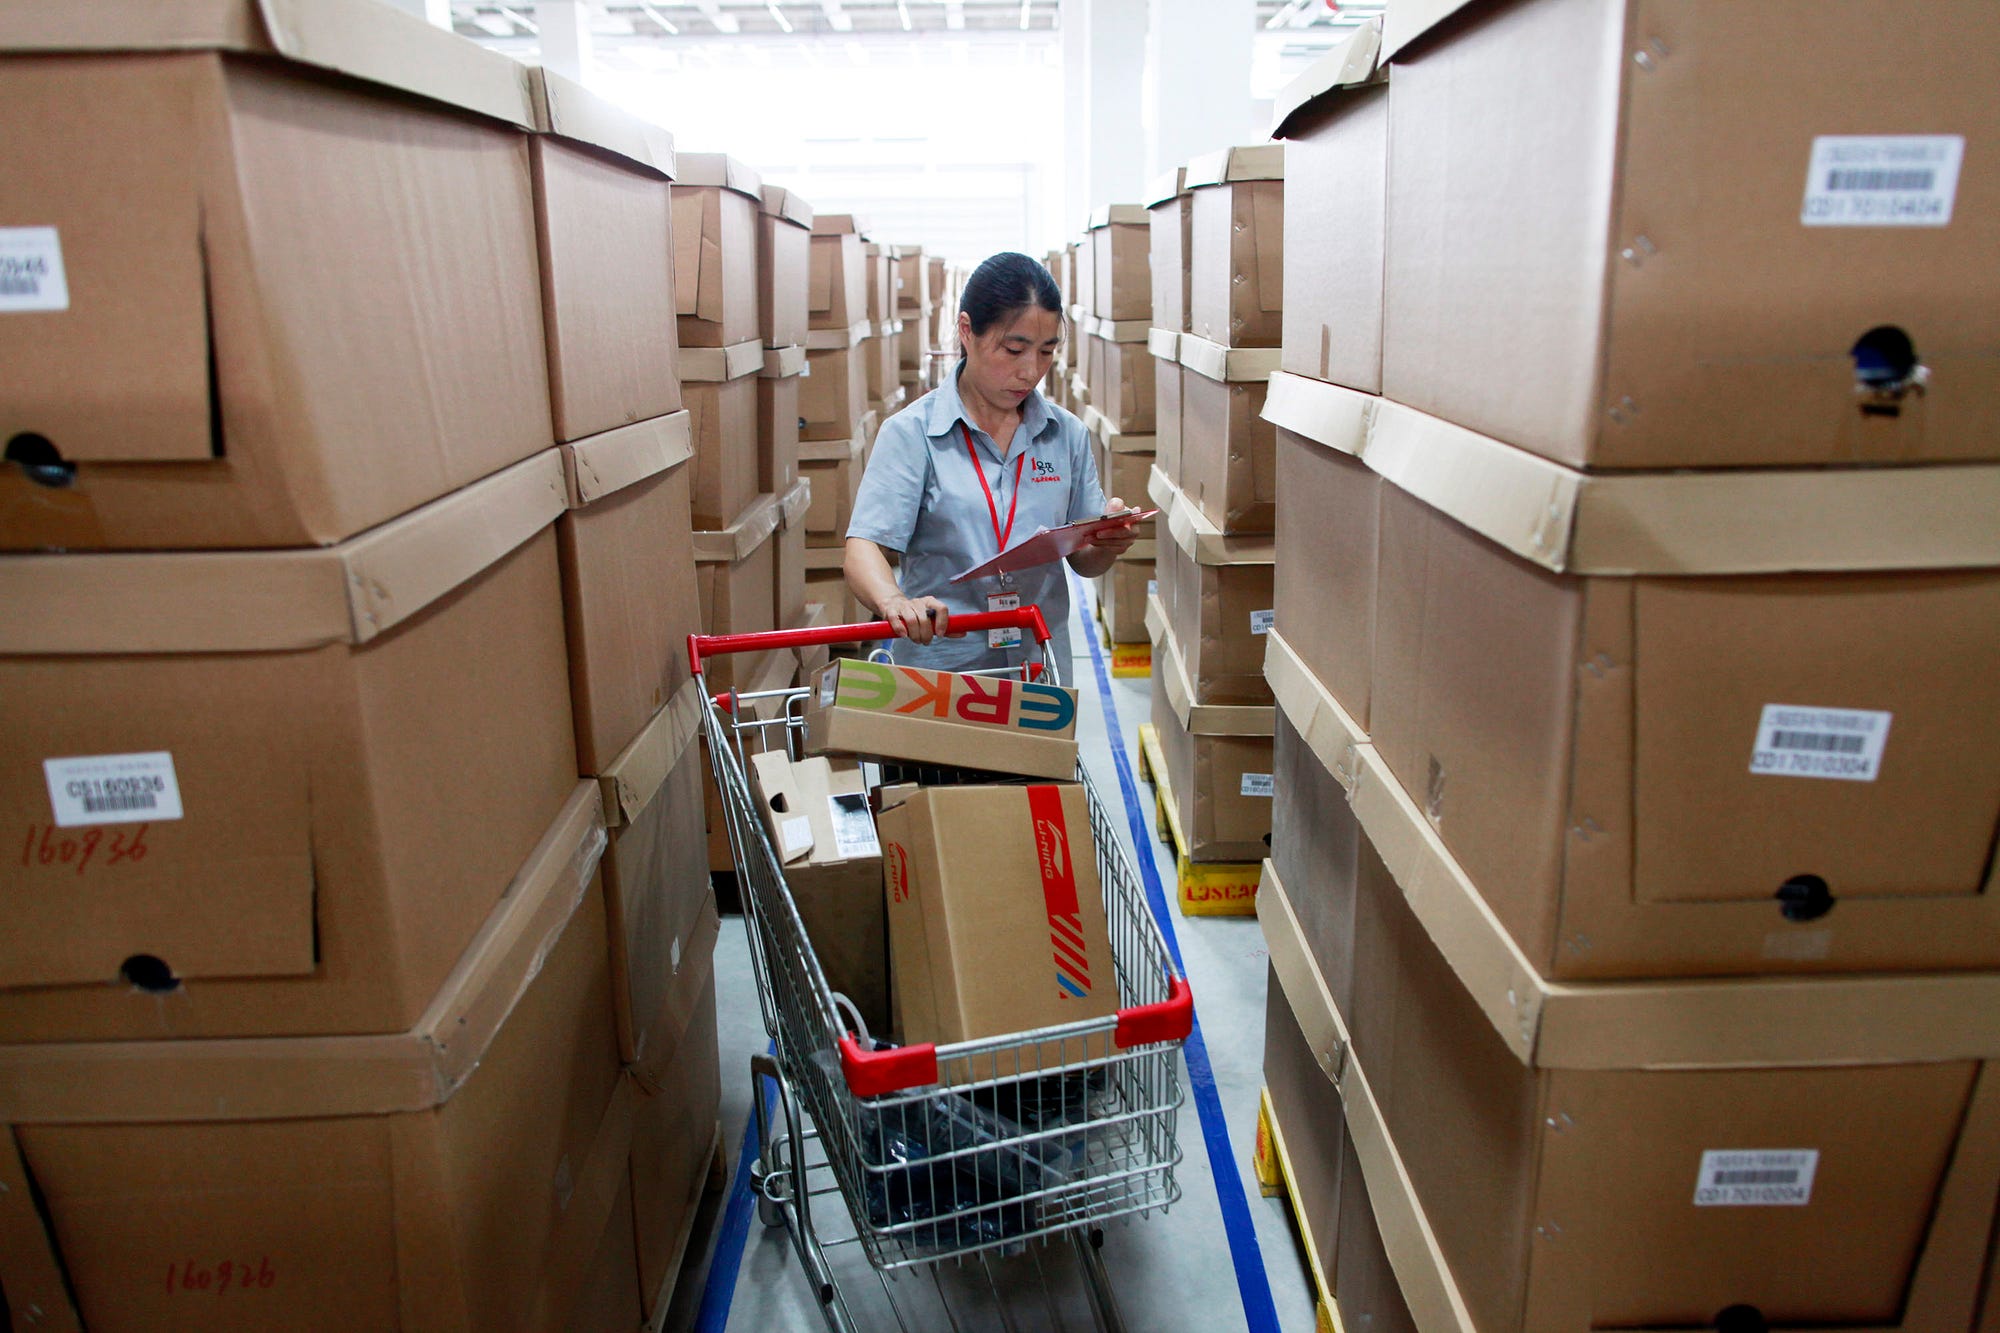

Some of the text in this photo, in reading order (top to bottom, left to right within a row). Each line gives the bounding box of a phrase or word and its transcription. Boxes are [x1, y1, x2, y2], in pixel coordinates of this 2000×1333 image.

[836, 658, 1075, 731] ERKE
[22, 823, 150, 876] 160936
[888, 842, 902, 904] LI-NING
[1037, 819, 1054, 880] LI-NING
[166, 1255, 276, 1296] 160926
